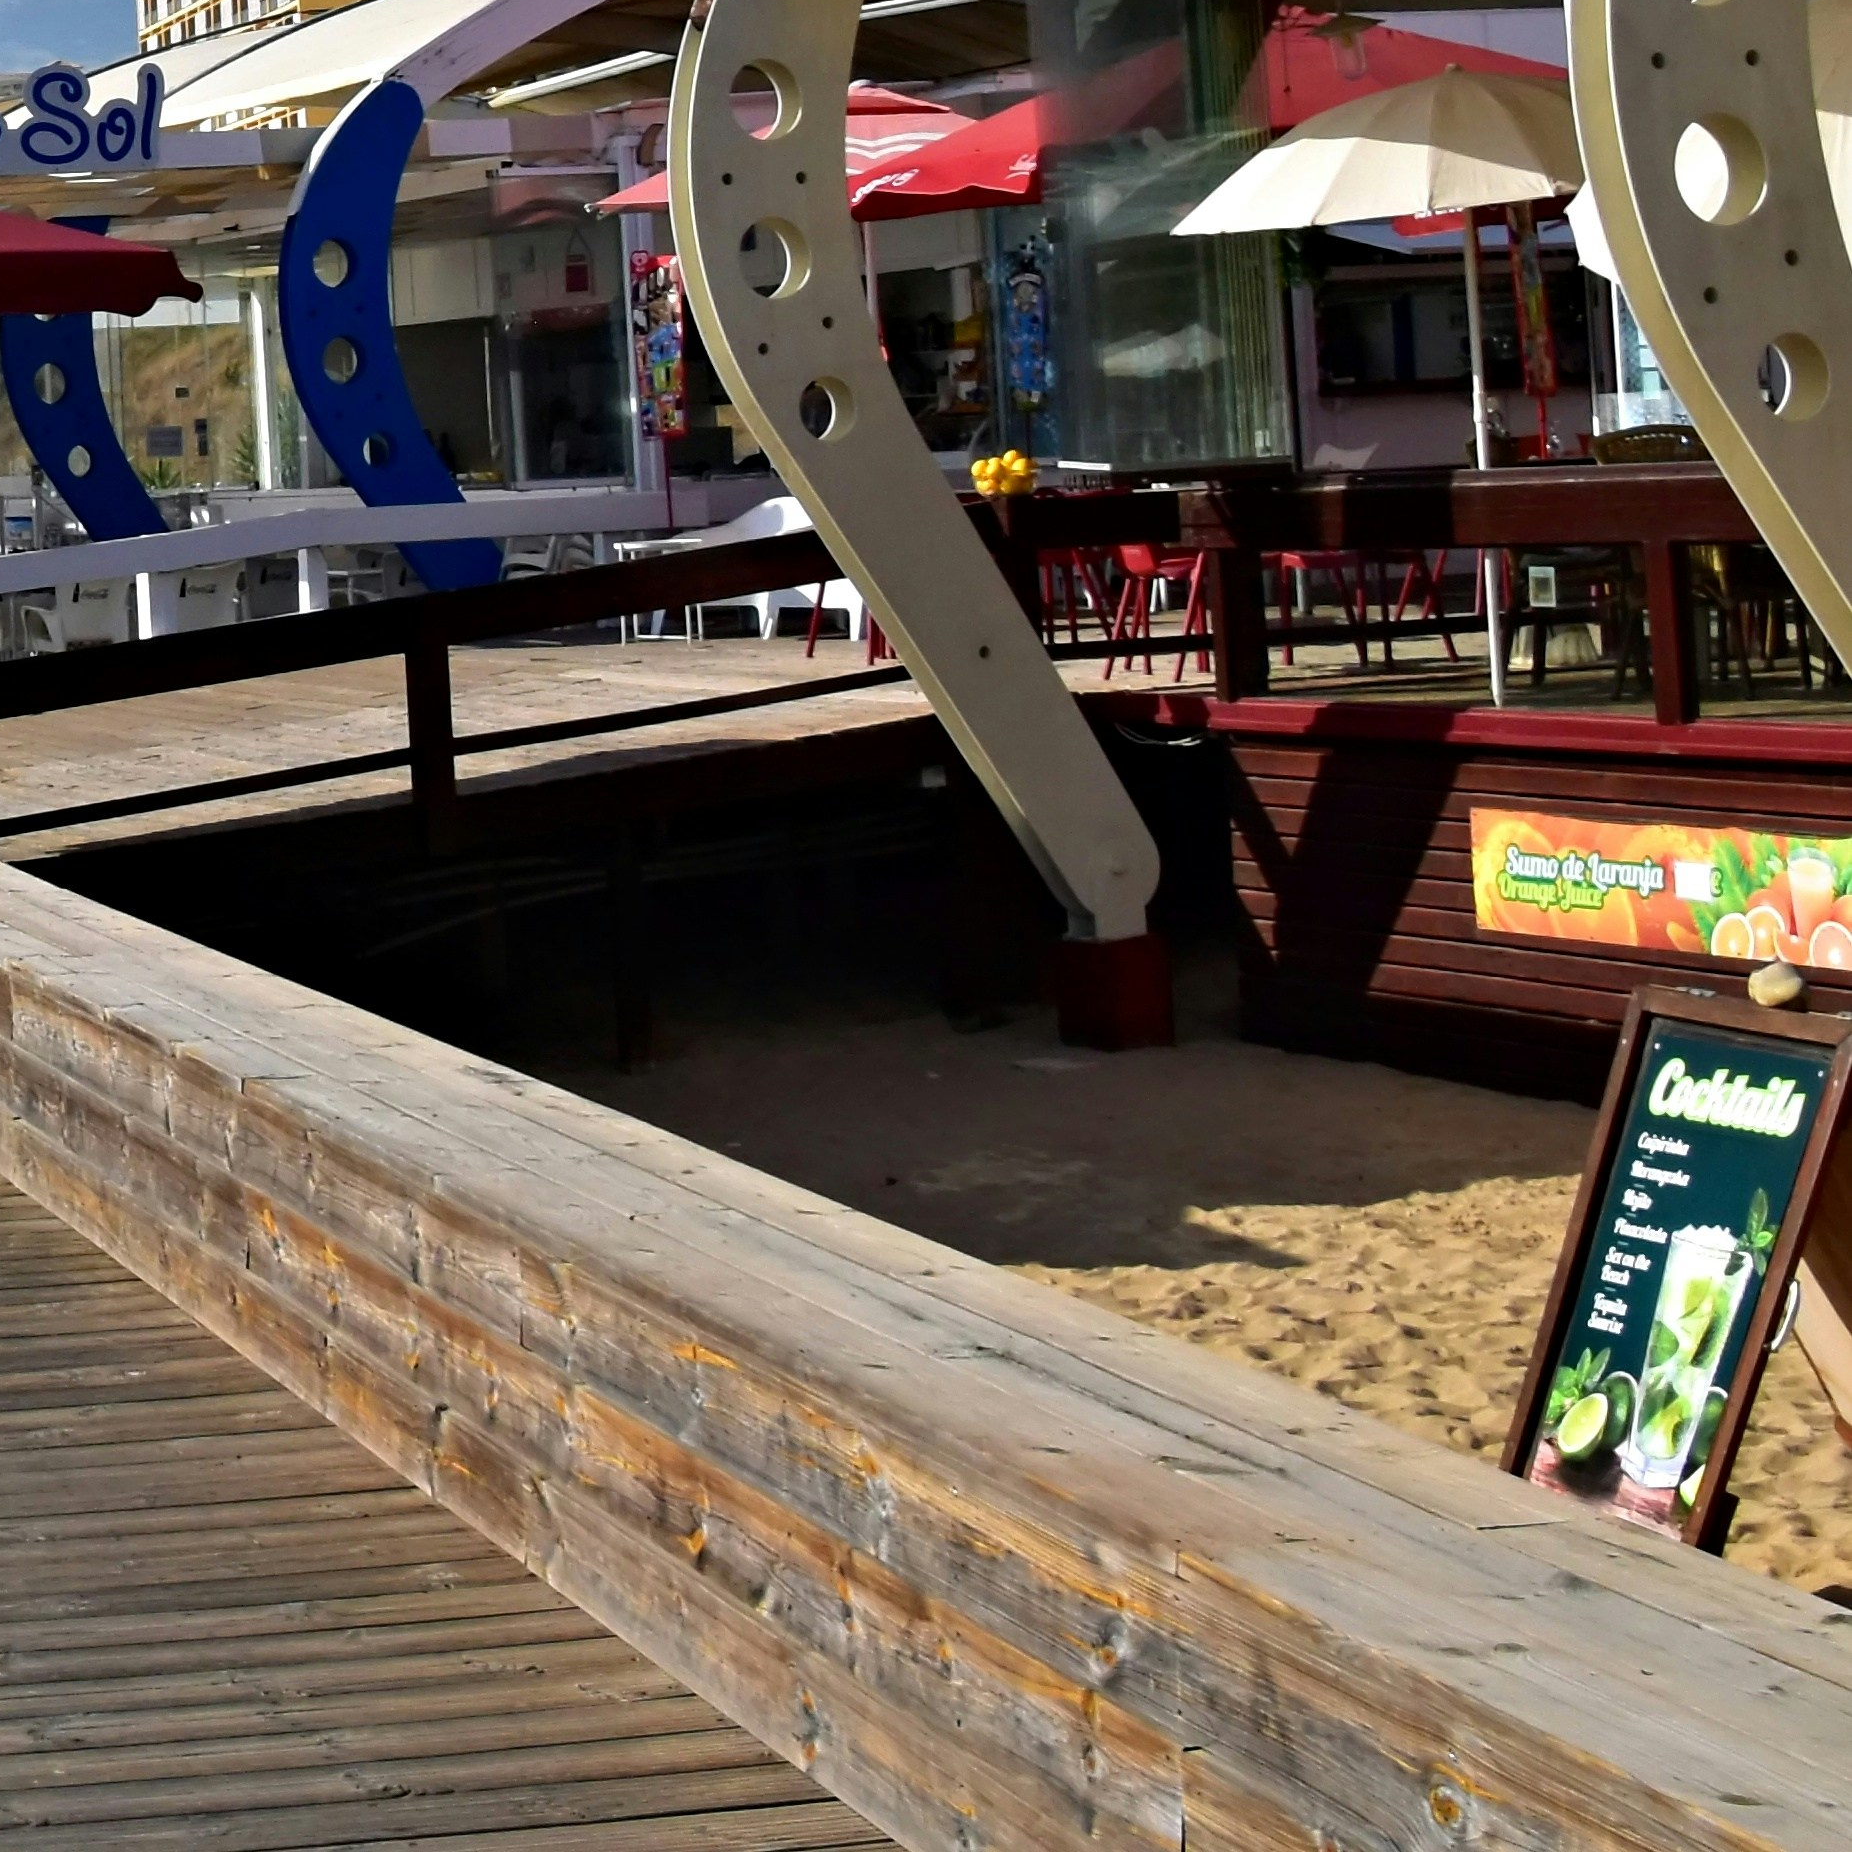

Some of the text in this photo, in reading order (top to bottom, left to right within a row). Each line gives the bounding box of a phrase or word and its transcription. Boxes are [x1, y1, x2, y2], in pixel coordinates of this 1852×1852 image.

[21, 72, 157, 165] Sol
[1498, 872, 1604, 912] Orange Juice
[1505, 845, 1664, 897] Sumo de Laranja
[1649, 1057, 1806, 1138] Cocktails
